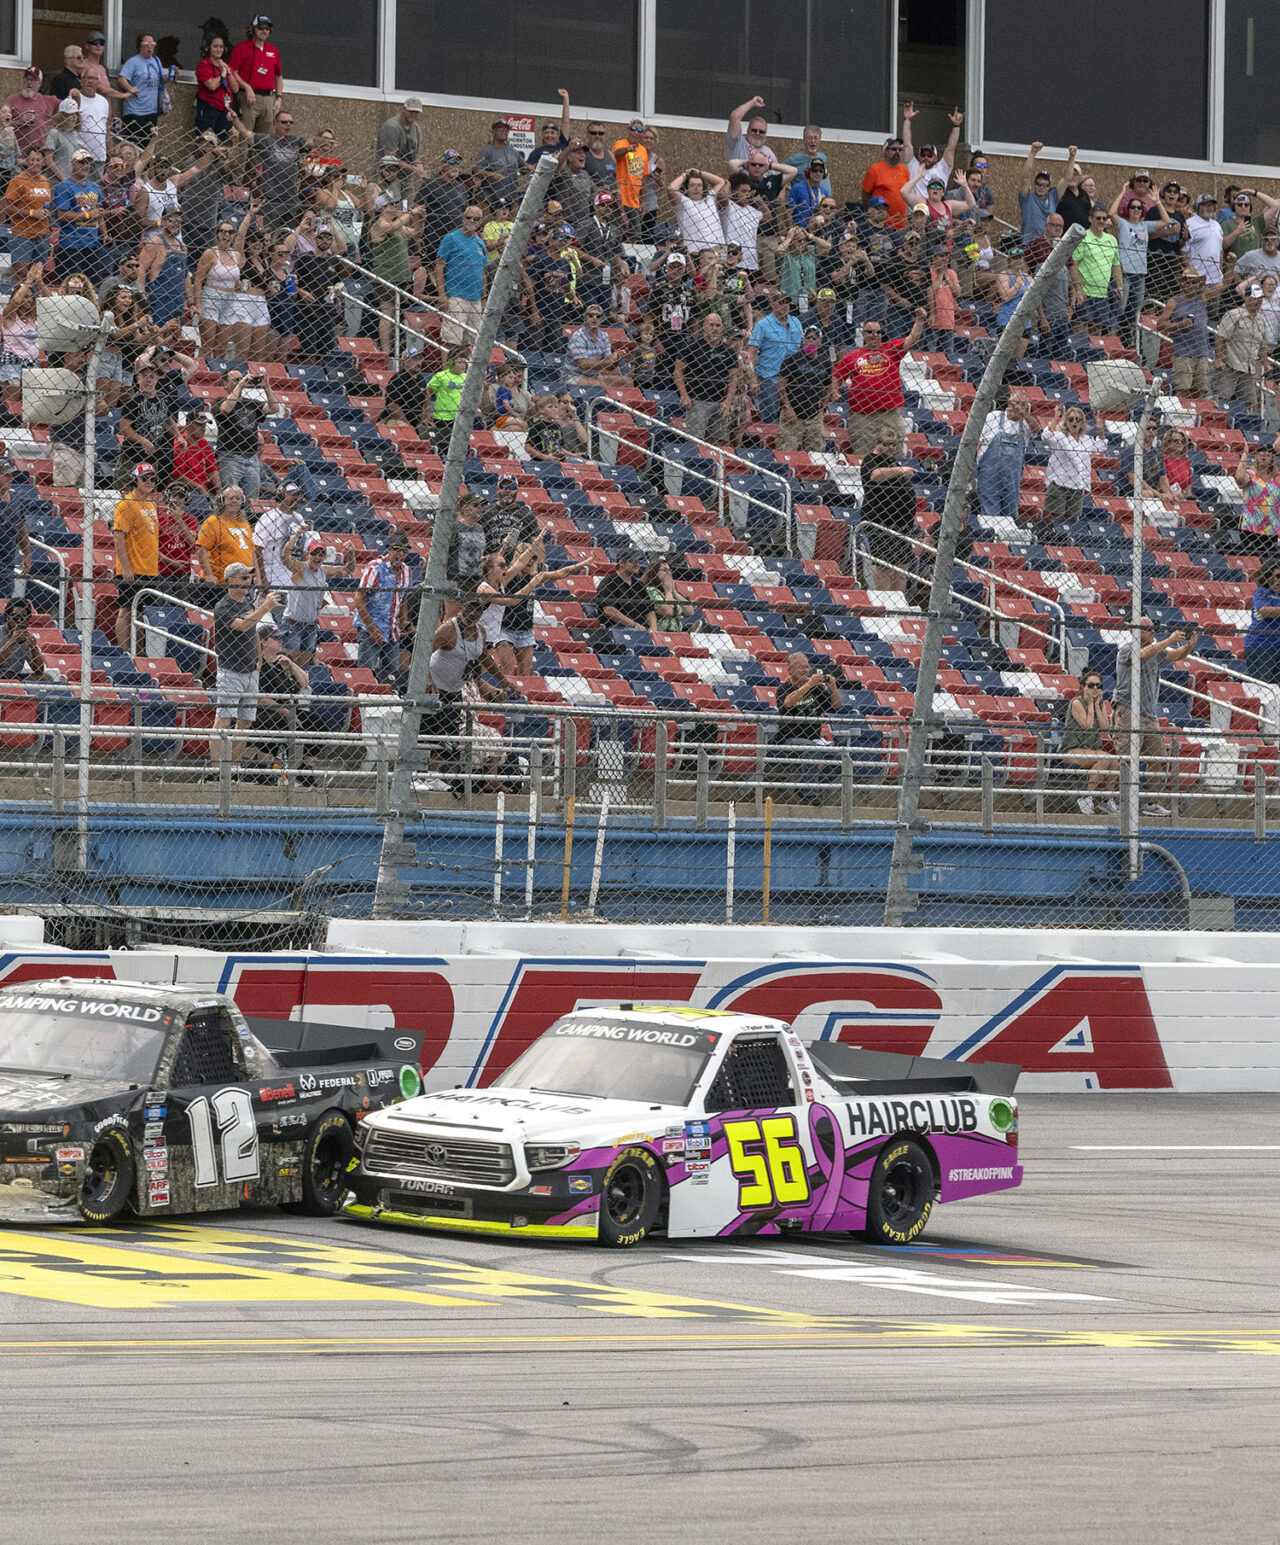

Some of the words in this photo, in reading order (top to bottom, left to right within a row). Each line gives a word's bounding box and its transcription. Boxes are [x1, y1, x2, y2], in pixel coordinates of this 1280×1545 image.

[80, 1001, 162, 1023] WORLD
[554, 1023, 624, 1040] CAMPING
[628, 1029, 696, 1047] WORLD
[319, 1077, 357, 1088] FEDERAL
[423, 1092, 592, 1115] HAIRCLUB
[845, 1100, 978, 1135] HAIRCLUB
[184, 1086, 261, 1188] 12
[722, 1116, 809, 1208] 56
[948, 1167, 1014, 1181] #STREAKOFPINK
[400, 1179, 455, 1195] TUNDRA
[617, 1227, 645, 1245] EAGLE
